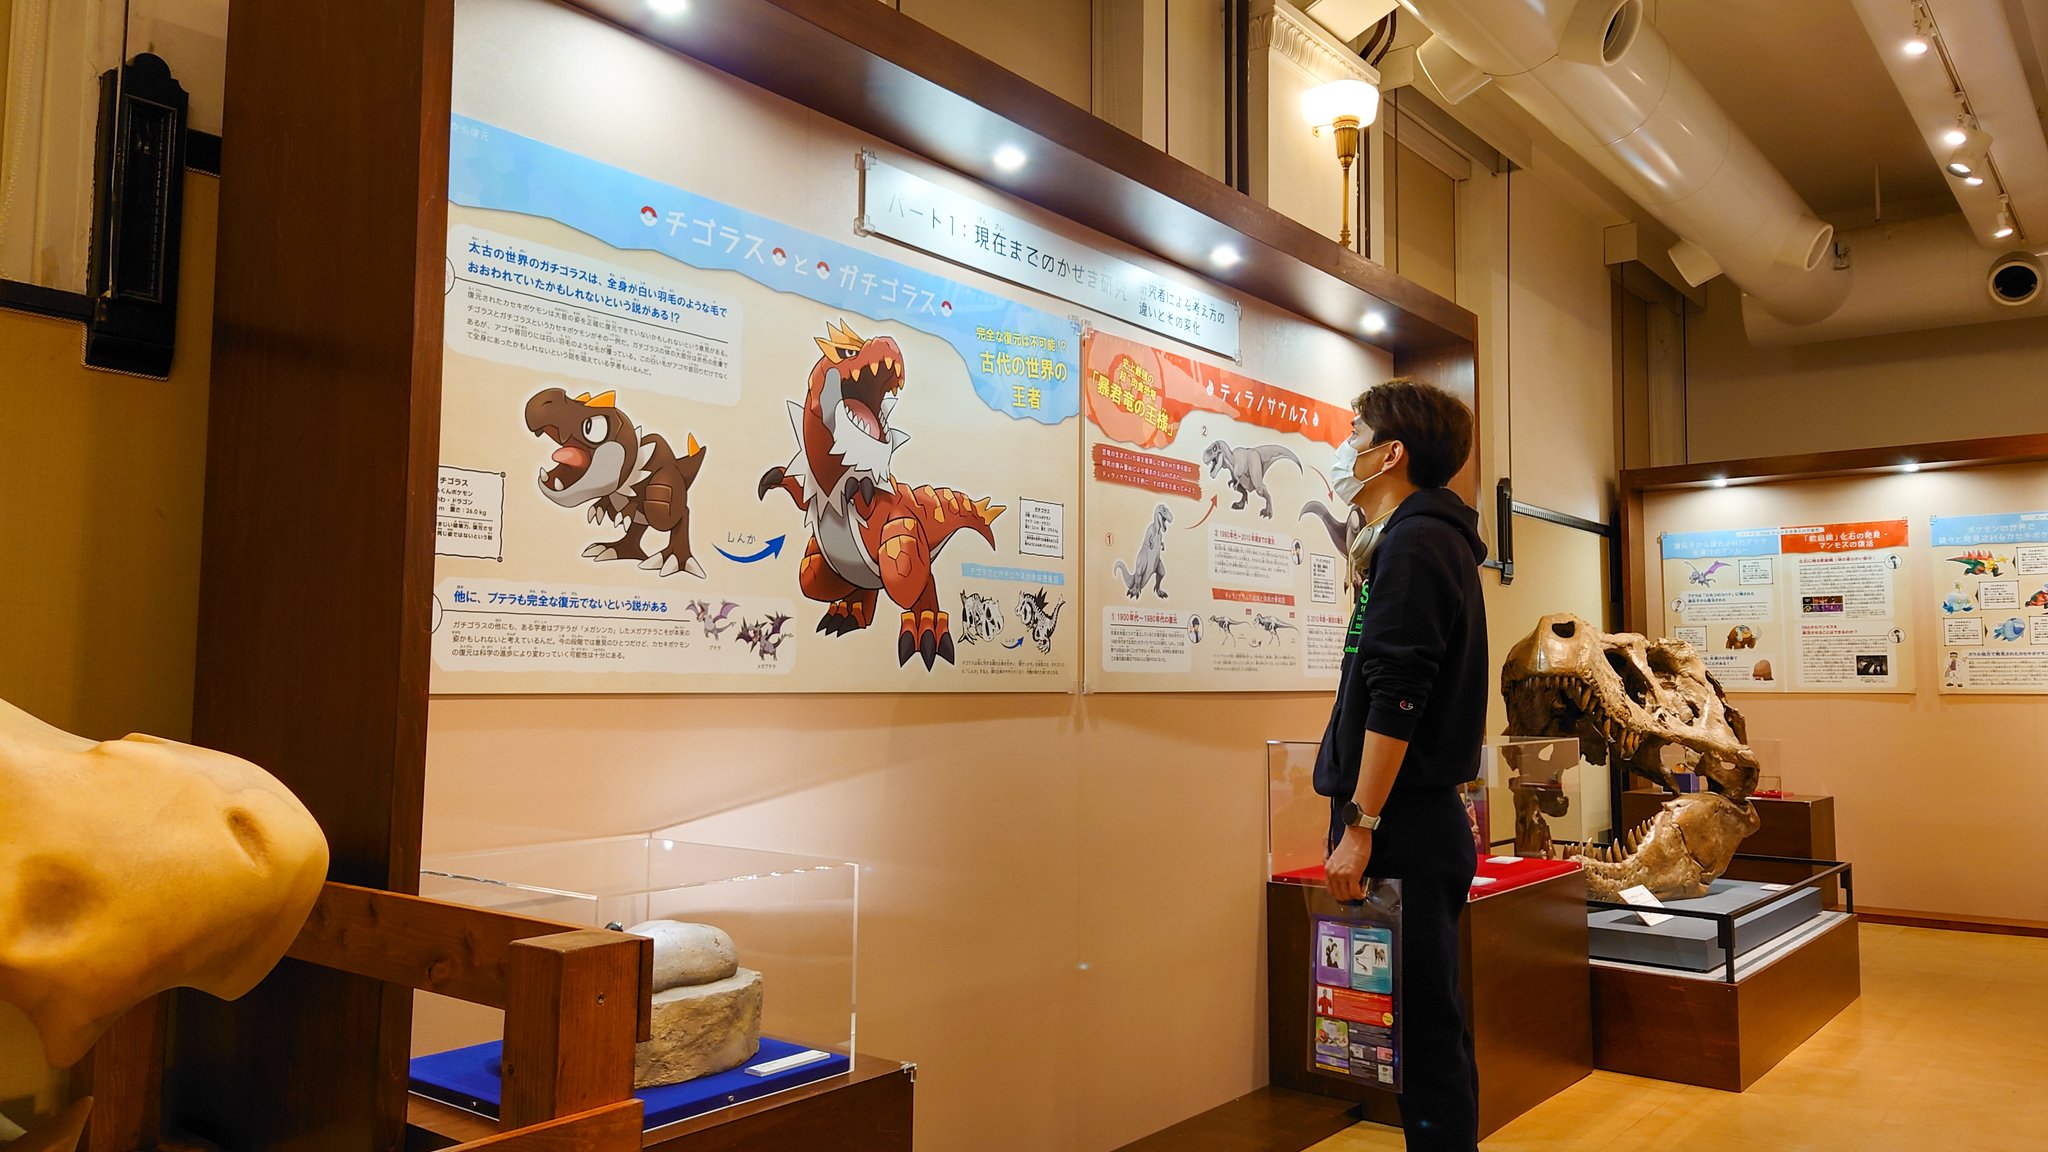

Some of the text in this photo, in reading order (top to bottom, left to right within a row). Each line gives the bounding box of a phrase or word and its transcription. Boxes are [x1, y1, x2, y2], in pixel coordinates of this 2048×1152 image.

[468, 241, 727, 317] 太古の世界のガチゴラスは、全身が白い羽毛のような毛で
[666, 211, 937, 317] チゴラス と ガチゴラス
[1139, 301, 1201, 336] 違いとその変化
[980, 350, 1067, 382] 古代の世界の
[1012, 385, 1041, 410] 王者
[1220, 383, 1309, 426] ティラノサウルス
[440, 477, 469, 487] チゴラス
[728, 531, 756, 545] しんか
[453, 590, 669, 614] 他に、プテラも完全な復元でないという説がある
